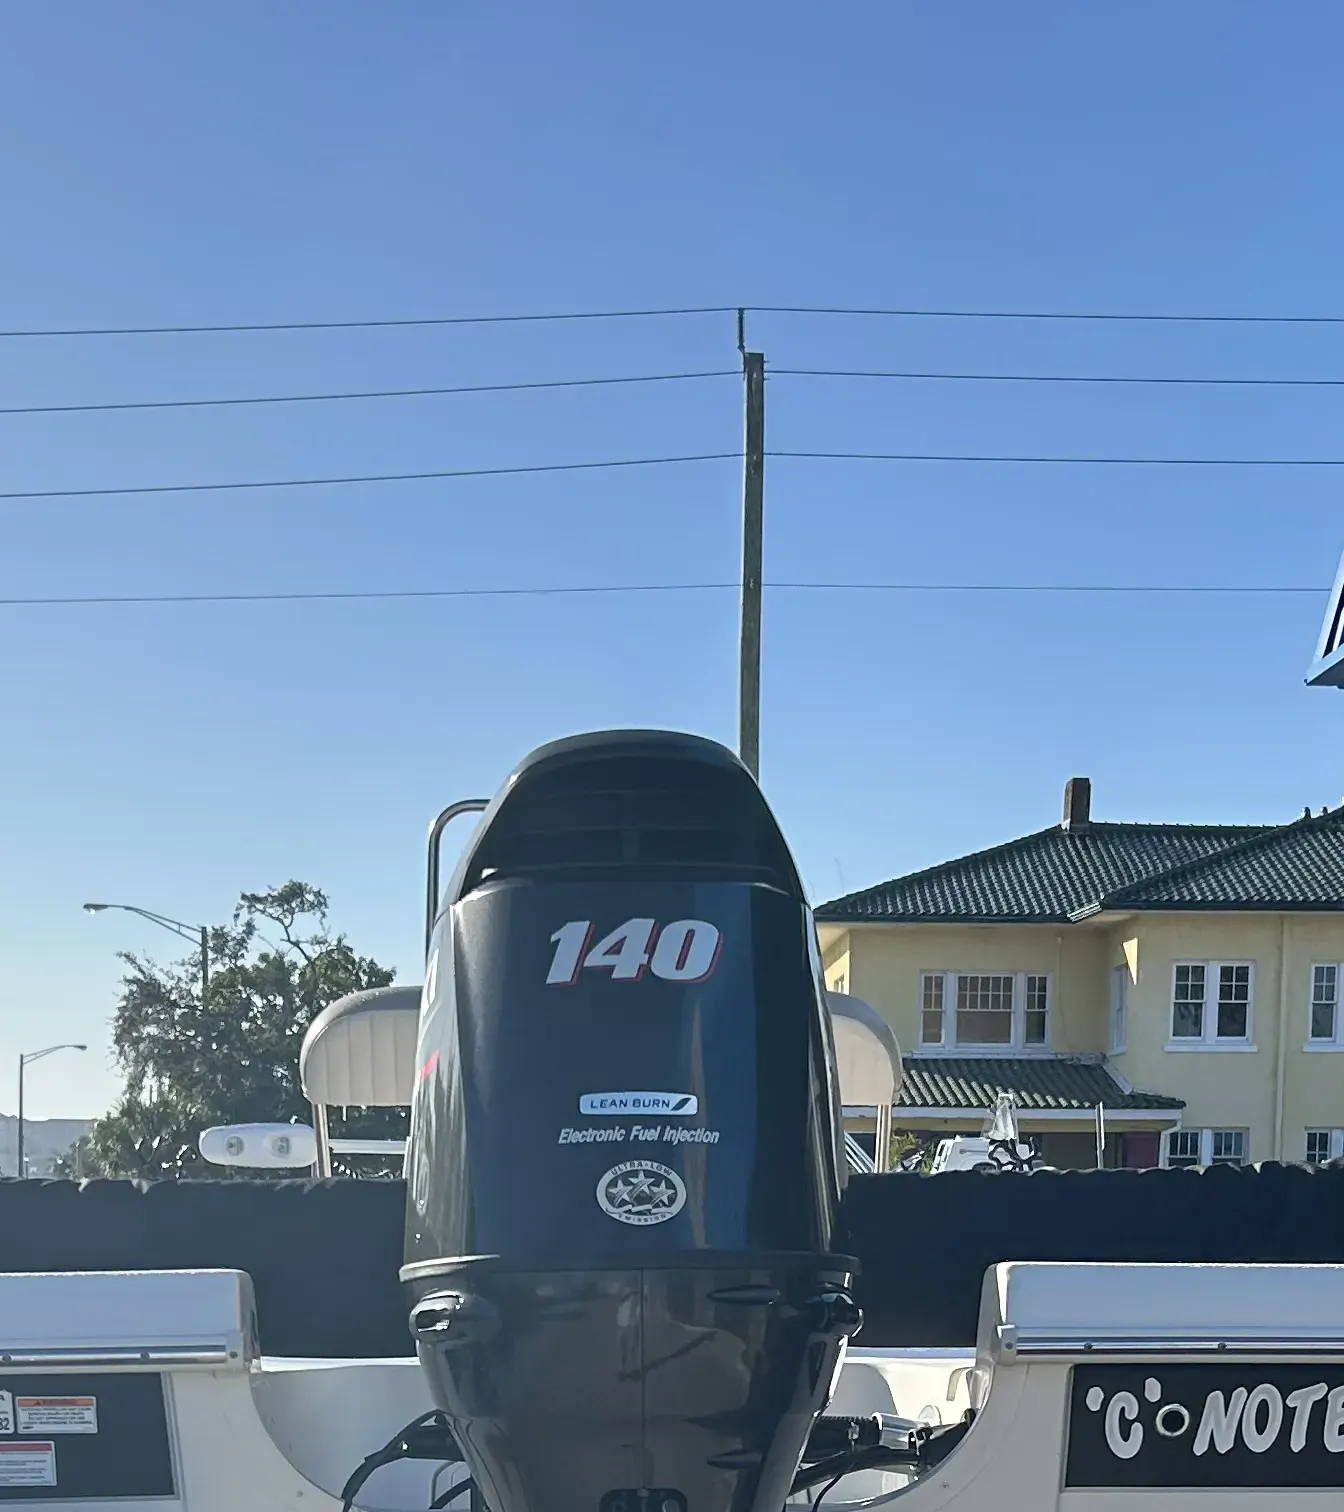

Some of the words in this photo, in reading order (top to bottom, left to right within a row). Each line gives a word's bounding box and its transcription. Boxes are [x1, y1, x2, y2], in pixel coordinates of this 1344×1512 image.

[546, 917, 723, 986] 140
[590, 1099, 628, 1110] LEAN
[631, 1098, 671, 1110] BURN
[558, 1125, 626, 1145] Electronic
[629, 1125, 662, 1142] Fuel
[663, 1125, 720, 1146] Injection
